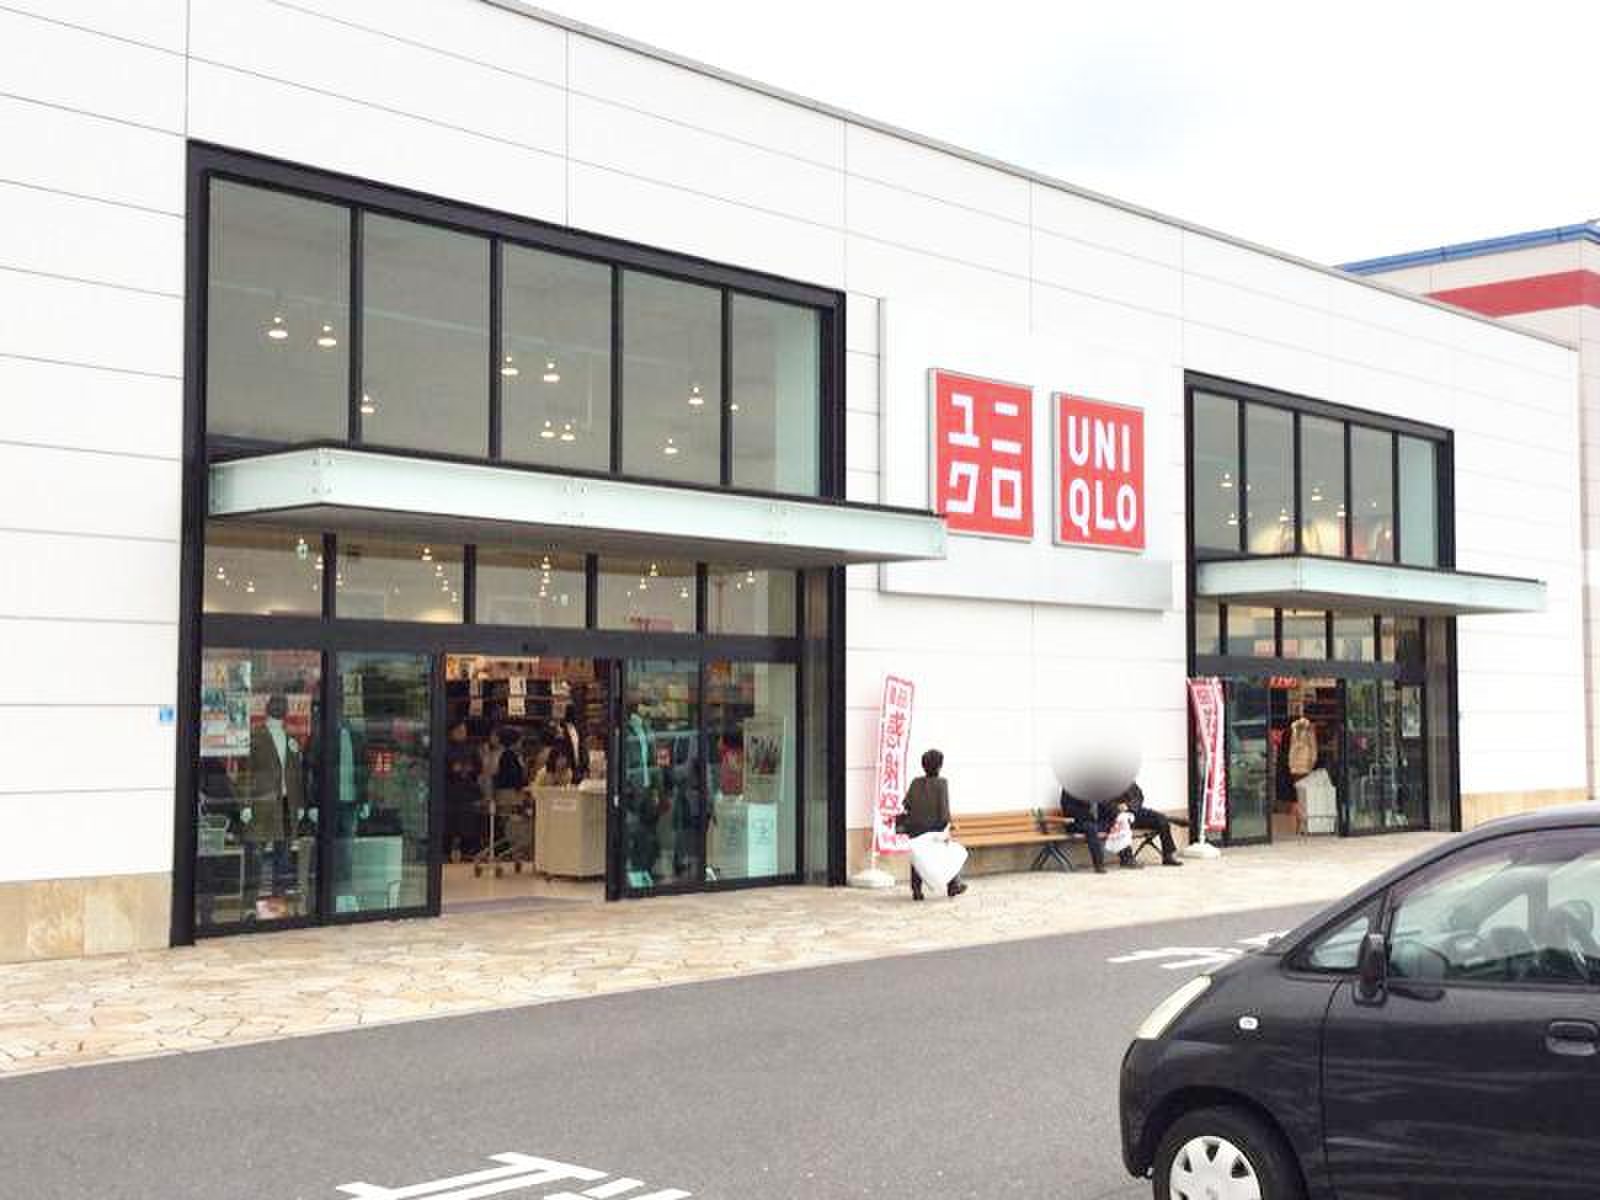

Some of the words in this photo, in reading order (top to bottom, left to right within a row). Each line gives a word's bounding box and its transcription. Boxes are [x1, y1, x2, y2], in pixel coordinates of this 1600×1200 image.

[948, 393, 1022, 455] ユニ
[1068, 415, 1130, 473] UNI
[946, 461, 1022, 520] クロ
[1069, 476, 1136, 537] QLO
